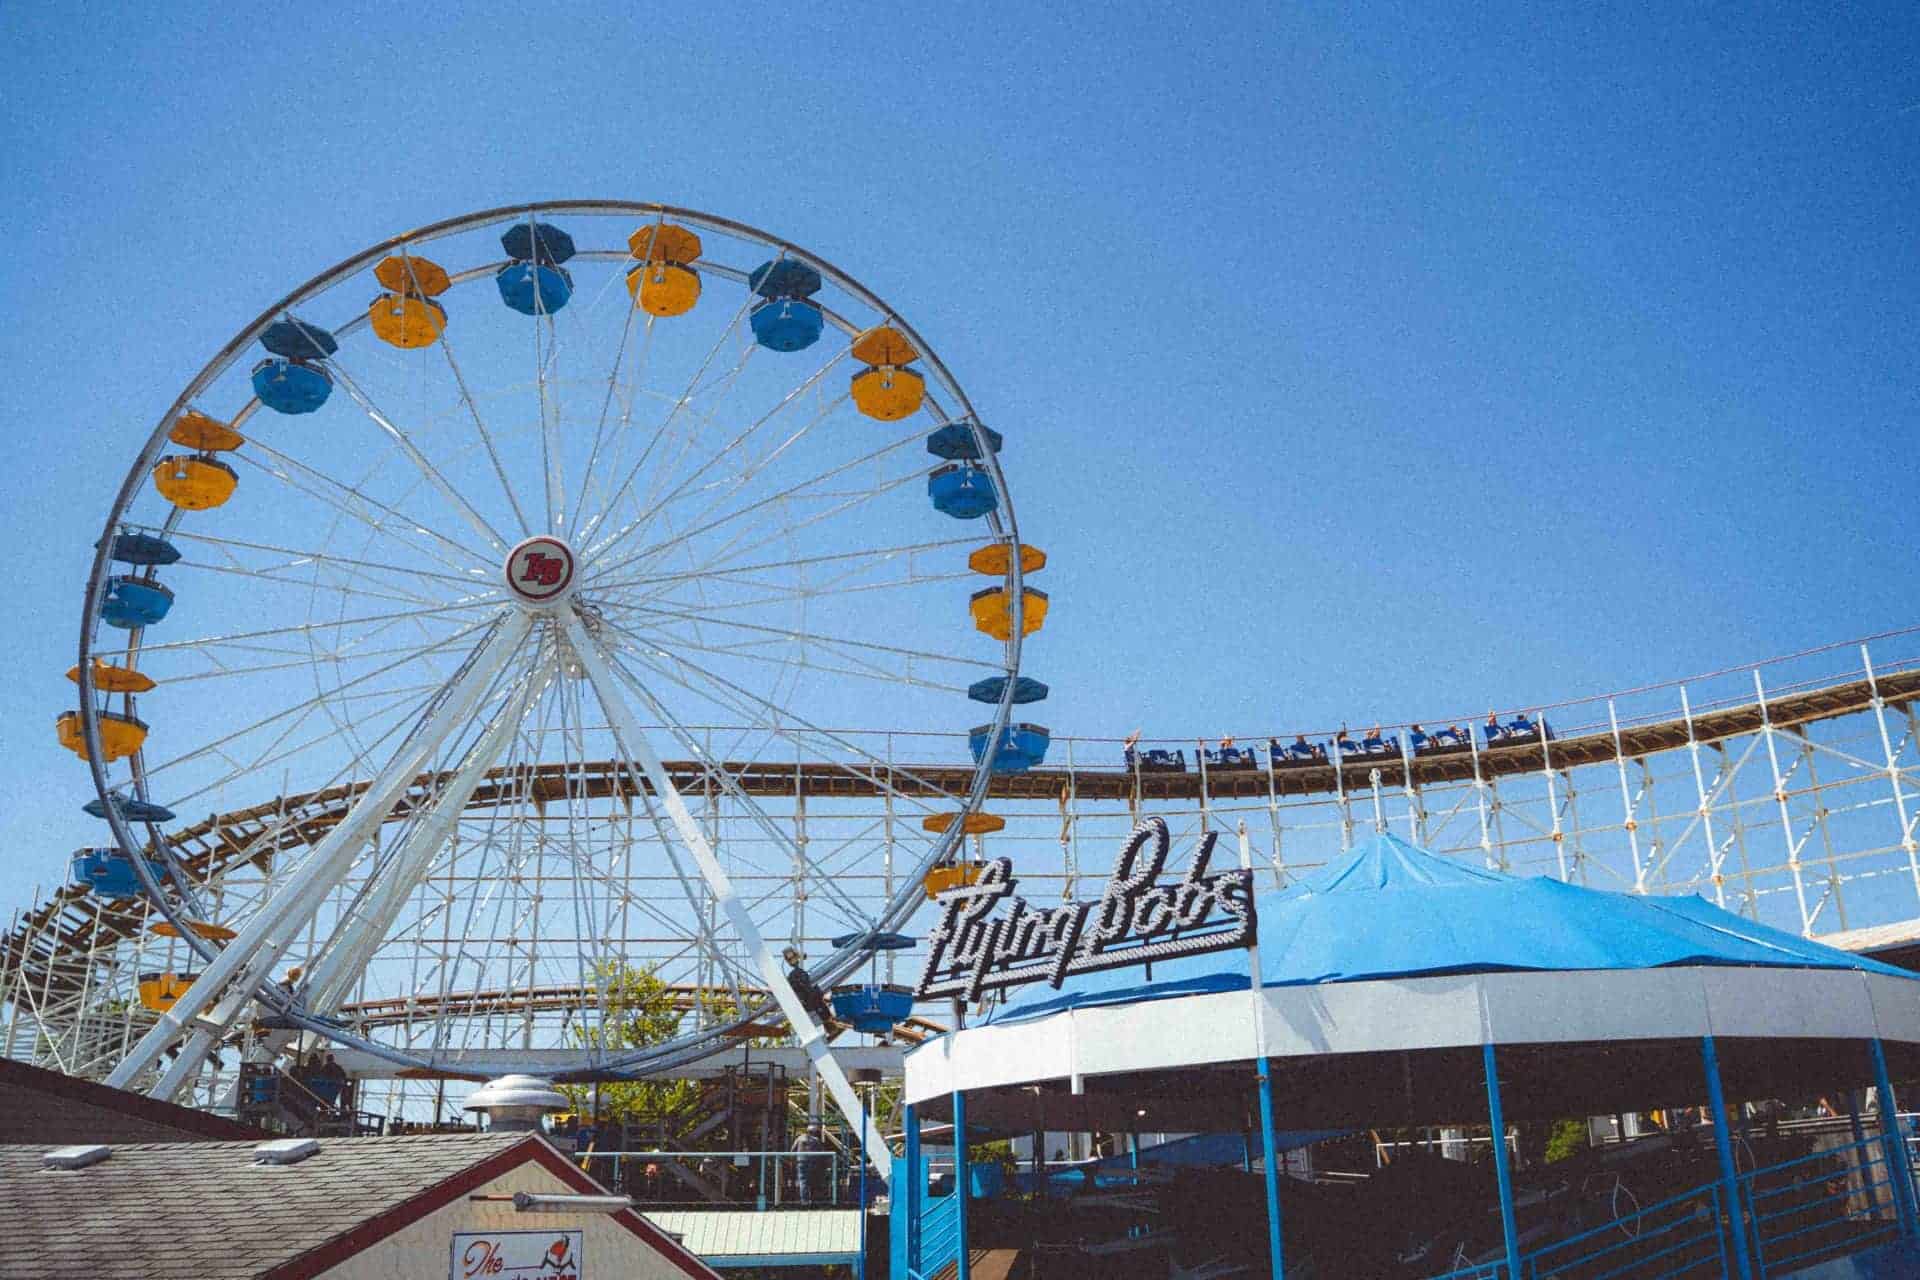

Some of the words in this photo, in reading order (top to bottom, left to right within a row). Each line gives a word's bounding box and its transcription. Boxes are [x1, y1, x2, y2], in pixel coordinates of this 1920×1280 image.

[916, 857, 1089, 1003] Flying
[1085, 816, 1254, 956] Bobs
[464, 1240, 503, 1278] The
